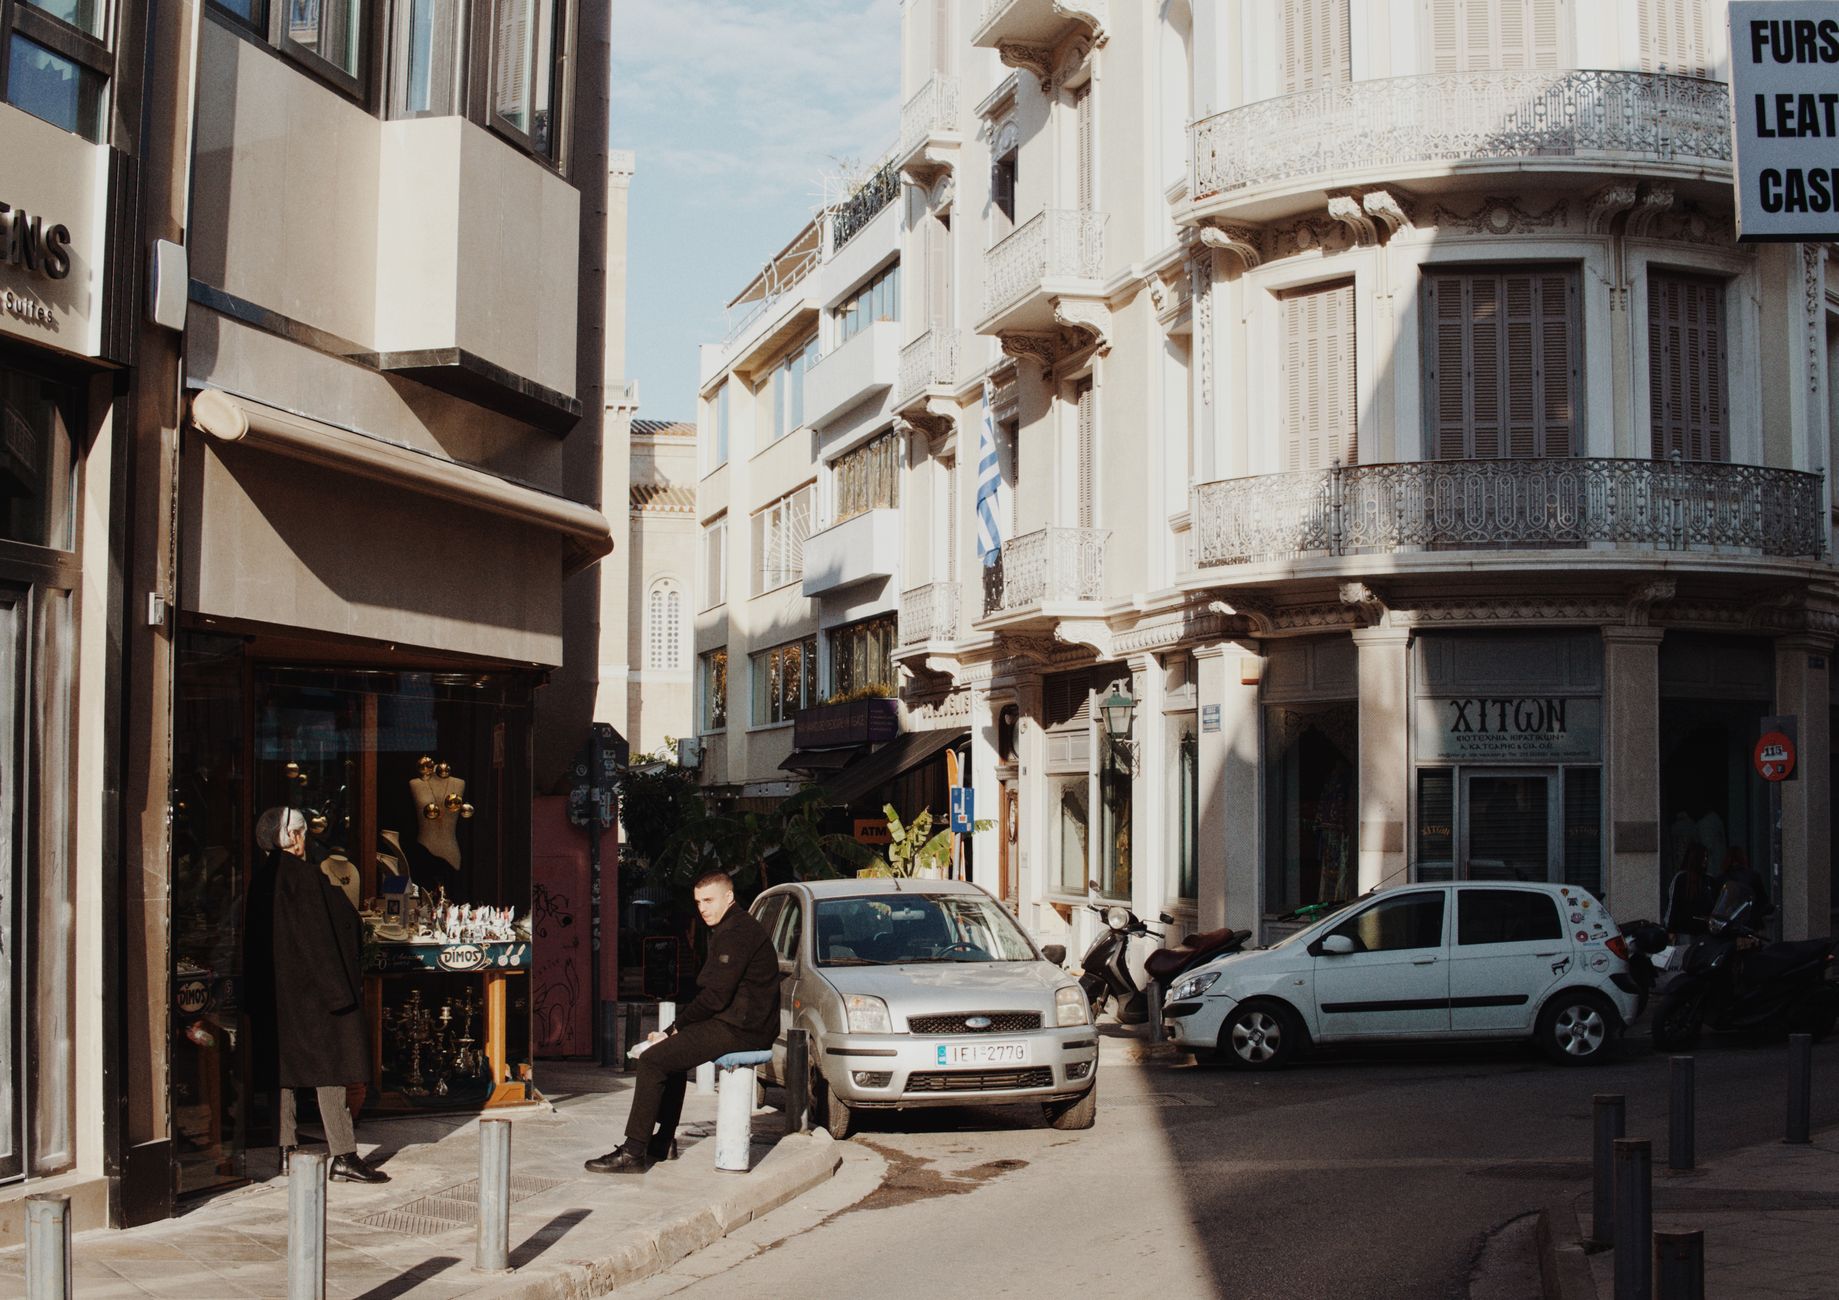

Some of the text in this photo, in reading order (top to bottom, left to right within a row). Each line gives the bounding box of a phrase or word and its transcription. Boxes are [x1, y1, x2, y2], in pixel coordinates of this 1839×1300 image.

[1750, 20, 1839, 64] FURS
[1755, 93, 1838, 138] LEAT
[6, 291, 53, 324] Suites
[860, 826, 886, 837] ATM
